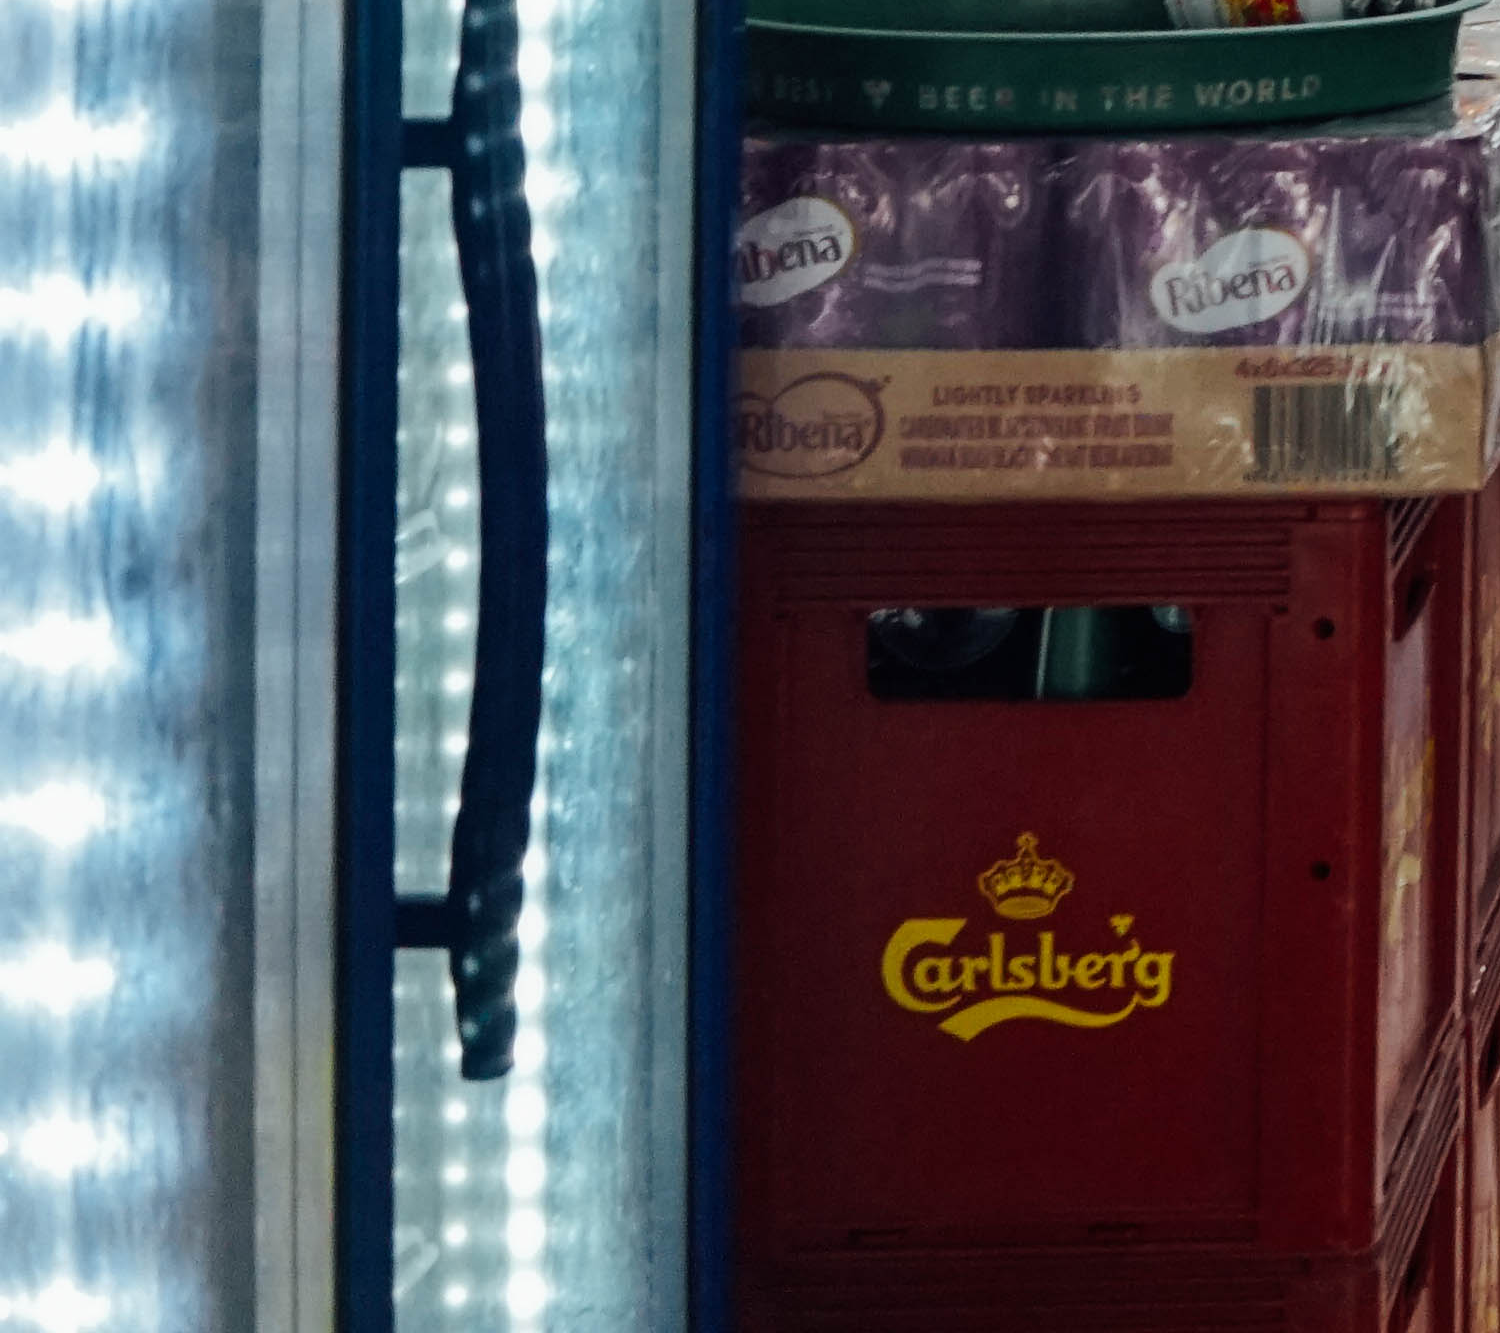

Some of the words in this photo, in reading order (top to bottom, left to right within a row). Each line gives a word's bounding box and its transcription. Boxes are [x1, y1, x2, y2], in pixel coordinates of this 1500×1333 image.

[1166, 259, 1295, 318] Ribena
[741, 411, 866, 453] Ribena
[883, 918, 1176, 1010] Carlsberg
